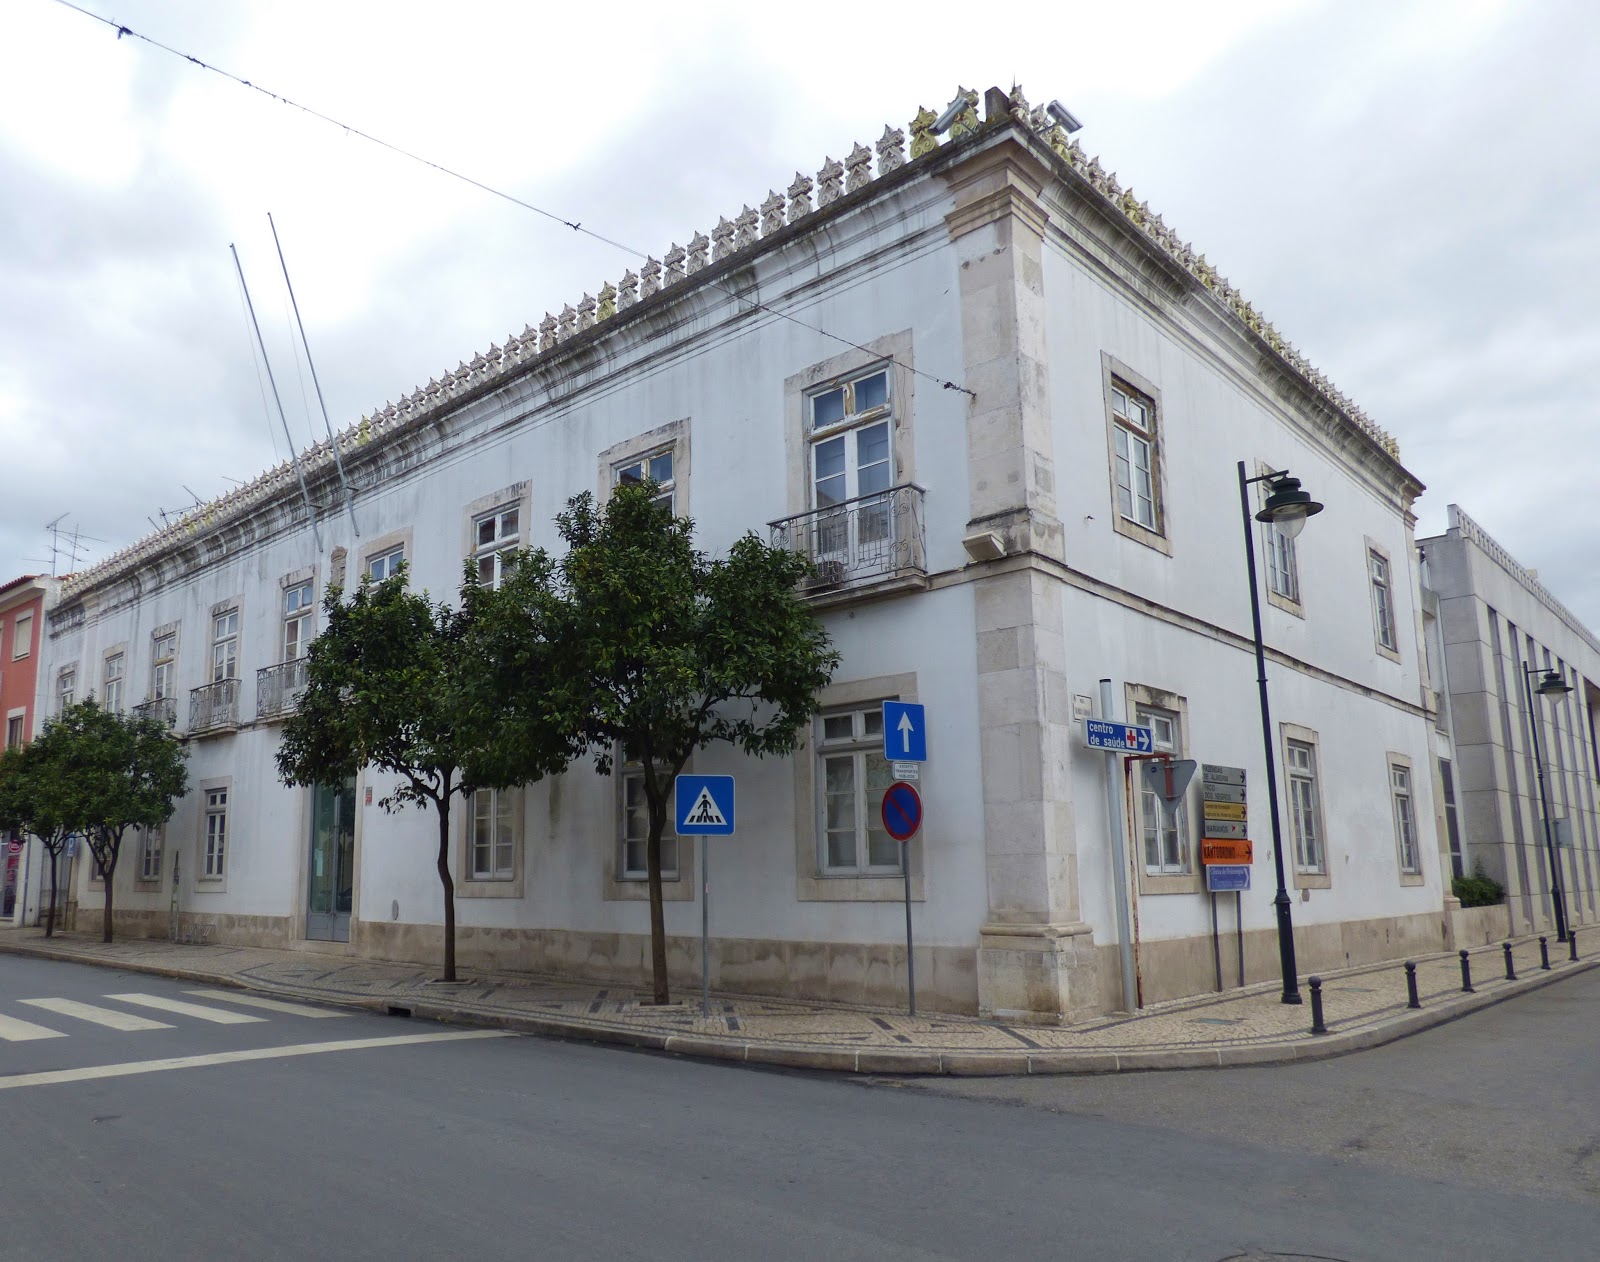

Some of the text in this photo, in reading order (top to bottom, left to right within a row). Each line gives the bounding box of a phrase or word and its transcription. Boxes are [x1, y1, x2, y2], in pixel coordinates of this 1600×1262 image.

[1089, 723, 1113, 734] centro
[1091, 734, 1125, 748] de saúde
